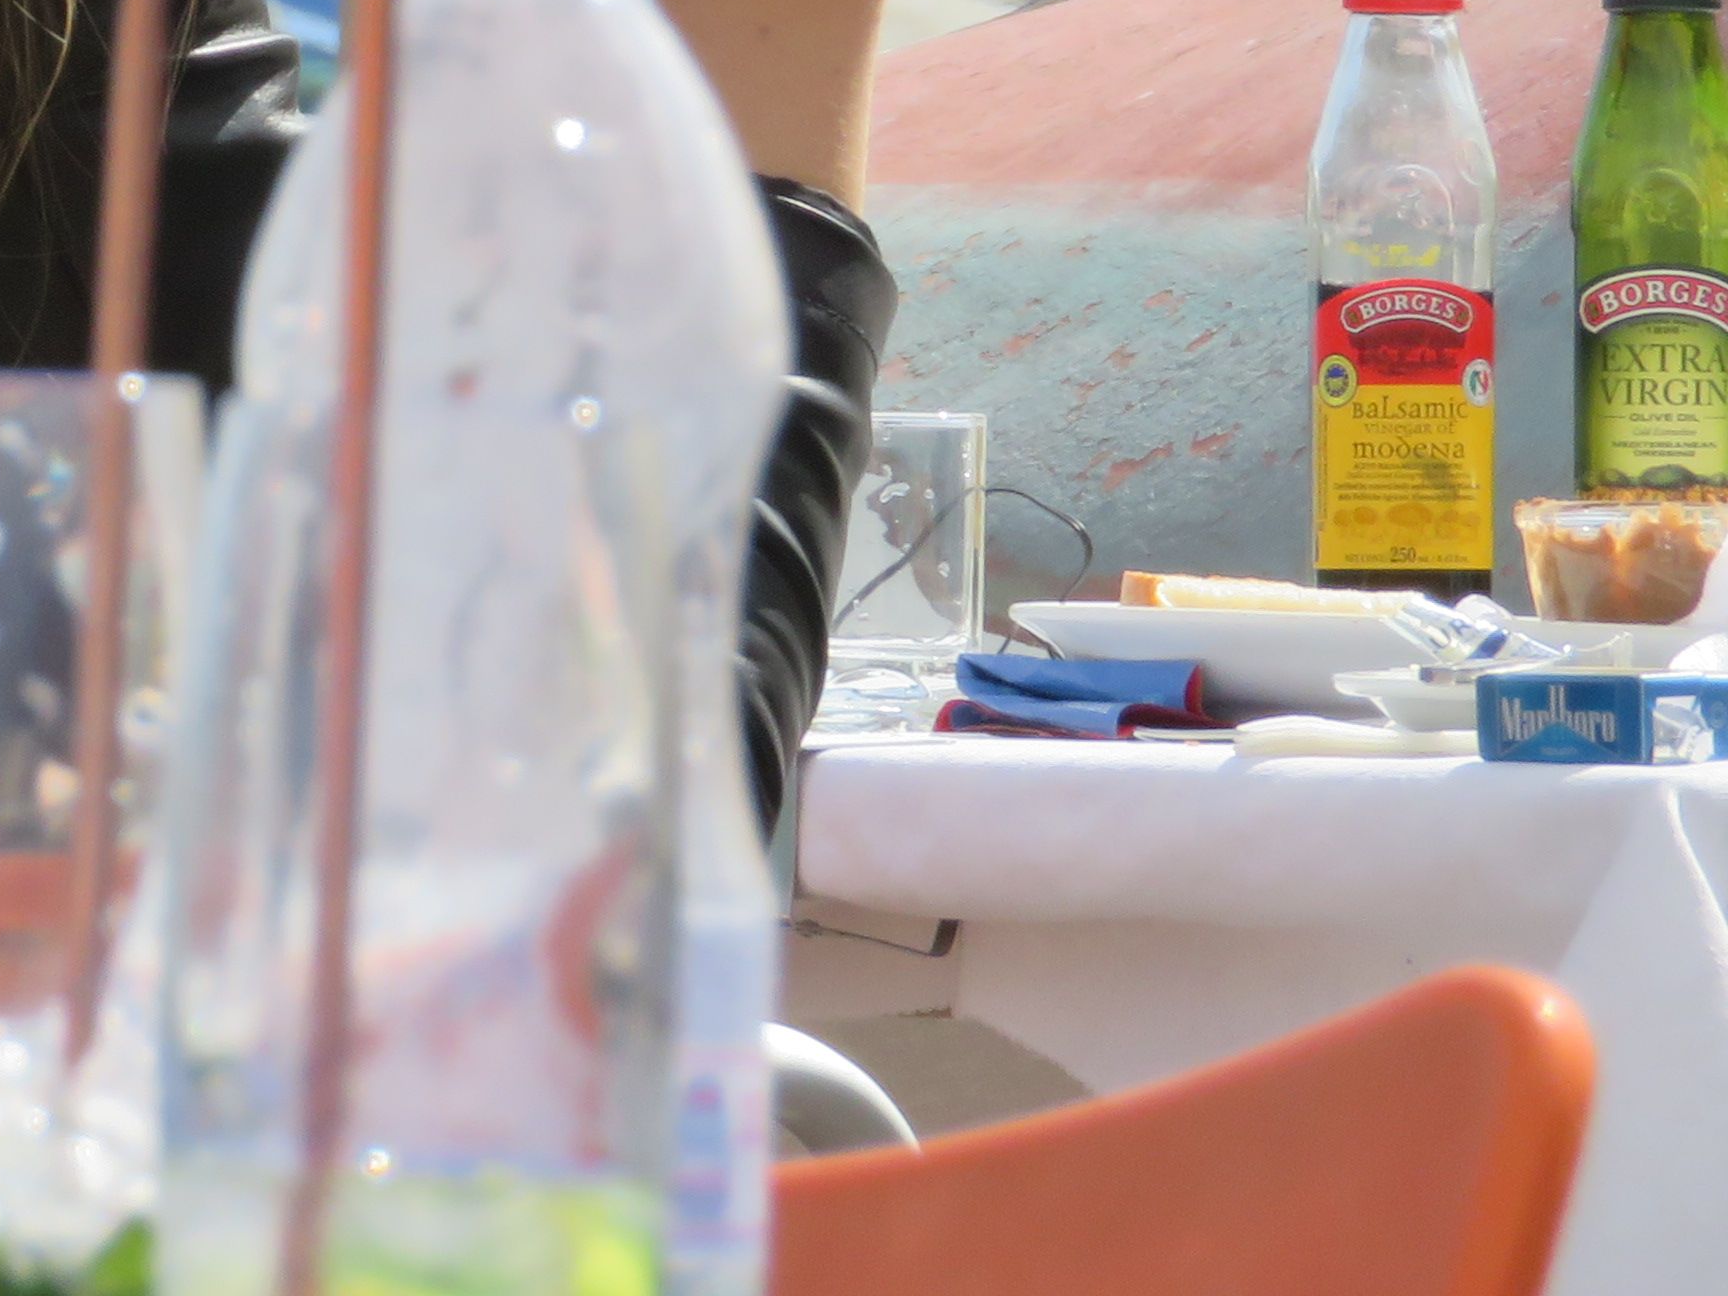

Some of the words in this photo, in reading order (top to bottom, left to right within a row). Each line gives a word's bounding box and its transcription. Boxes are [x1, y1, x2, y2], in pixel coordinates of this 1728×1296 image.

[1358, 294, 1458, 320] BORGES
[1598, 279, 1728, 315] BORGES
[1601, 342, 1728, 373] EXTRA
[1600, 377, 1728, 406] VIRGIN
[1628, 412, 1674, 422] OLIVE
[1389, 546, 1417, 563] 250
[1500, 683, 1617, 743] Marlboro
